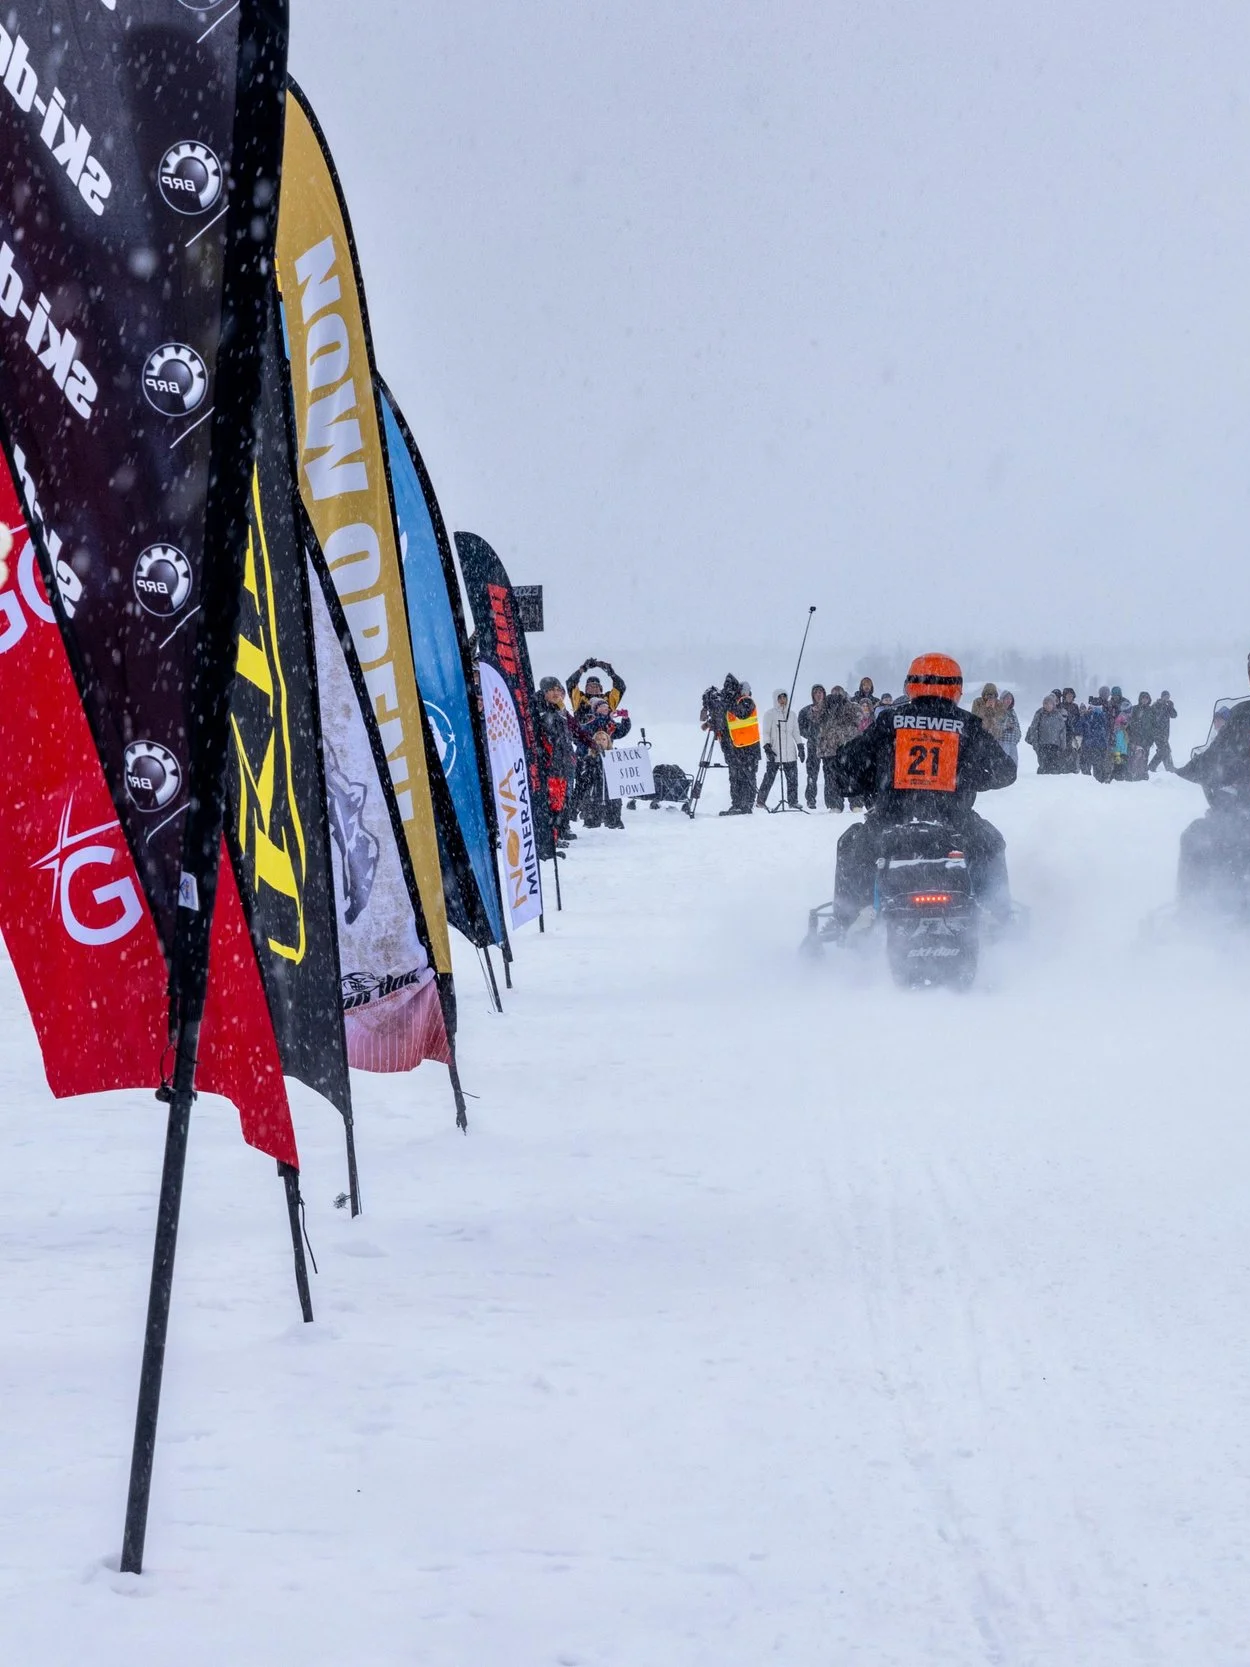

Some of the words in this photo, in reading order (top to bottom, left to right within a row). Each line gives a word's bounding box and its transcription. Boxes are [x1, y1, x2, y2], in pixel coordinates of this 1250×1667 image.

[294, 234, 369, 501] NOW
[893, 714, 965, 735] BREWER
[610, 749, 642, 762] TRACK
[907, 744, 941, 777] 21
[619, 766, 641, 779] SIDE
[619, 782, 645, 796] DOWN
[498, 766, 528, 909] NOVA
[514, 757, 539, 895] MINERALS
